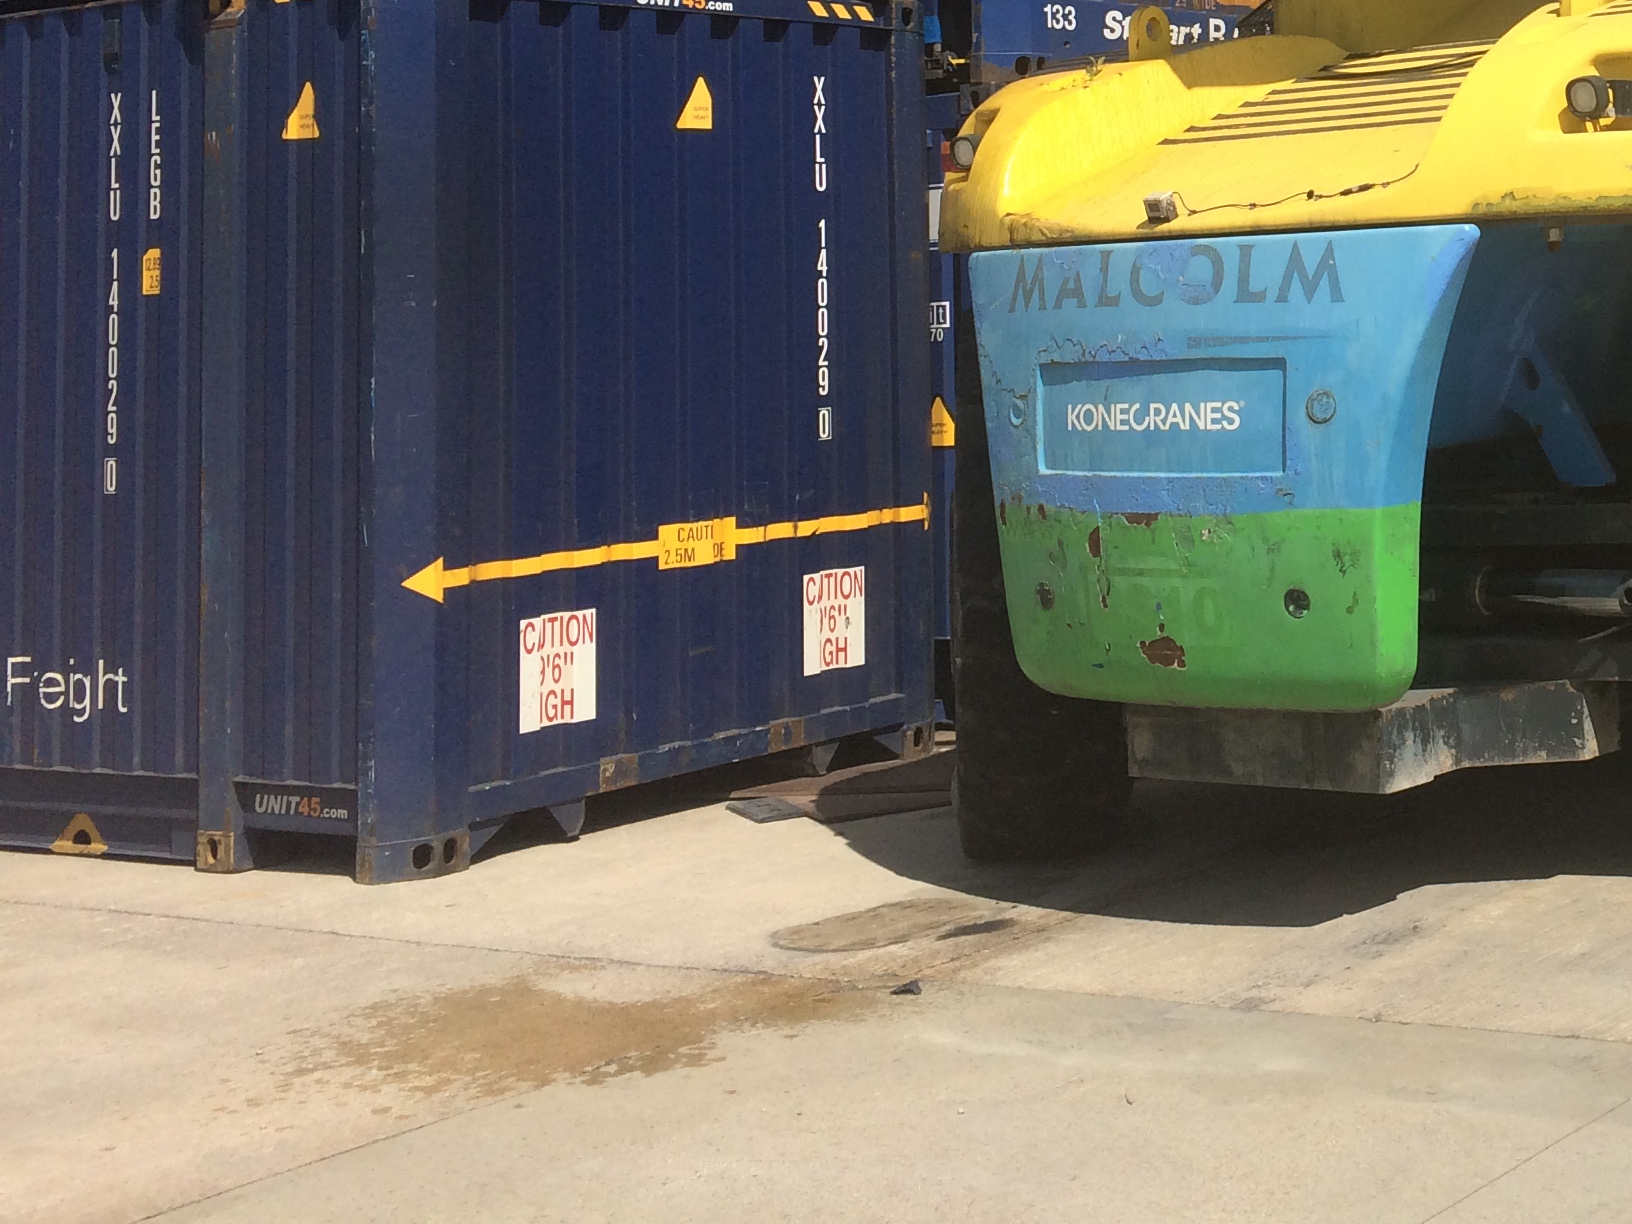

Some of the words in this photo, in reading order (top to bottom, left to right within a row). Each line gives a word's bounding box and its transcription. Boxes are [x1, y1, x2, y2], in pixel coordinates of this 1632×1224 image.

[1043, 3, 1077, 31] 133
[813, 76, 827, 192] XXLU
[109, 92, 122, 221] XXLU
[149, 90, 161, 220] LEGB
[149, 275, 160, 289] 2.5
[1008, 240, 1346, 313] MALCOLM
[816, 219, 829, 396] 140029
[107, 247, 119, 445] 140029
[930, 328, 944, 342] 70
[818, 408, 830, 440] 0
[1067, 400, 1241, 431] KONECRANES
[106, 460, 117, 493] 0
[677, 524, 714, 543] CAUTI
[664, 547, 696, 566] 2.5M
[6, 656, 128, 723] Feight
[254, 793, 348, 820] UNIT45.com
